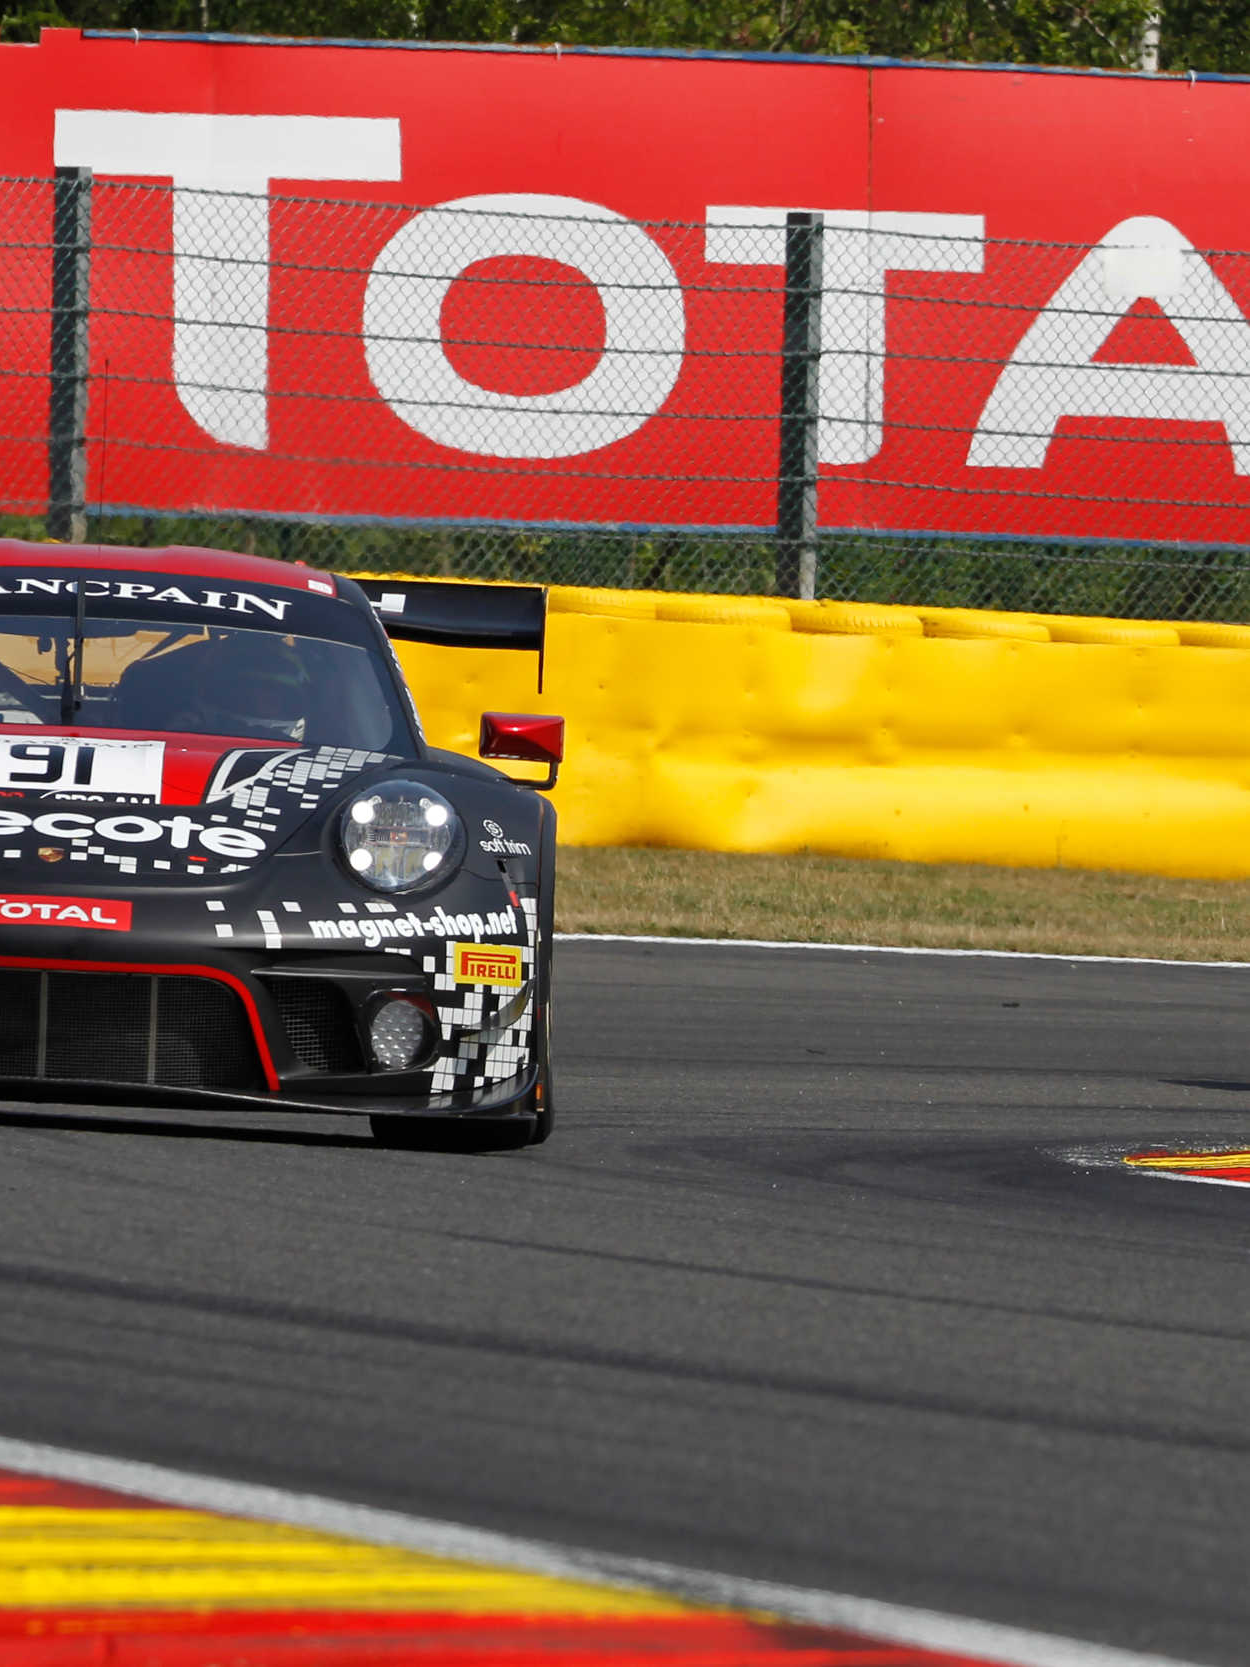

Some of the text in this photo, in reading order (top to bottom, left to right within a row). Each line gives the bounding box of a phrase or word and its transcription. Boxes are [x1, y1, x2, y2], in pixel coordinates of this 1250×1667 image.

[9, 743, 96, 786] 91
[308, 904, 518, 948] magnet-shop.net
[460, 951, 517, 980] PIRELLI
